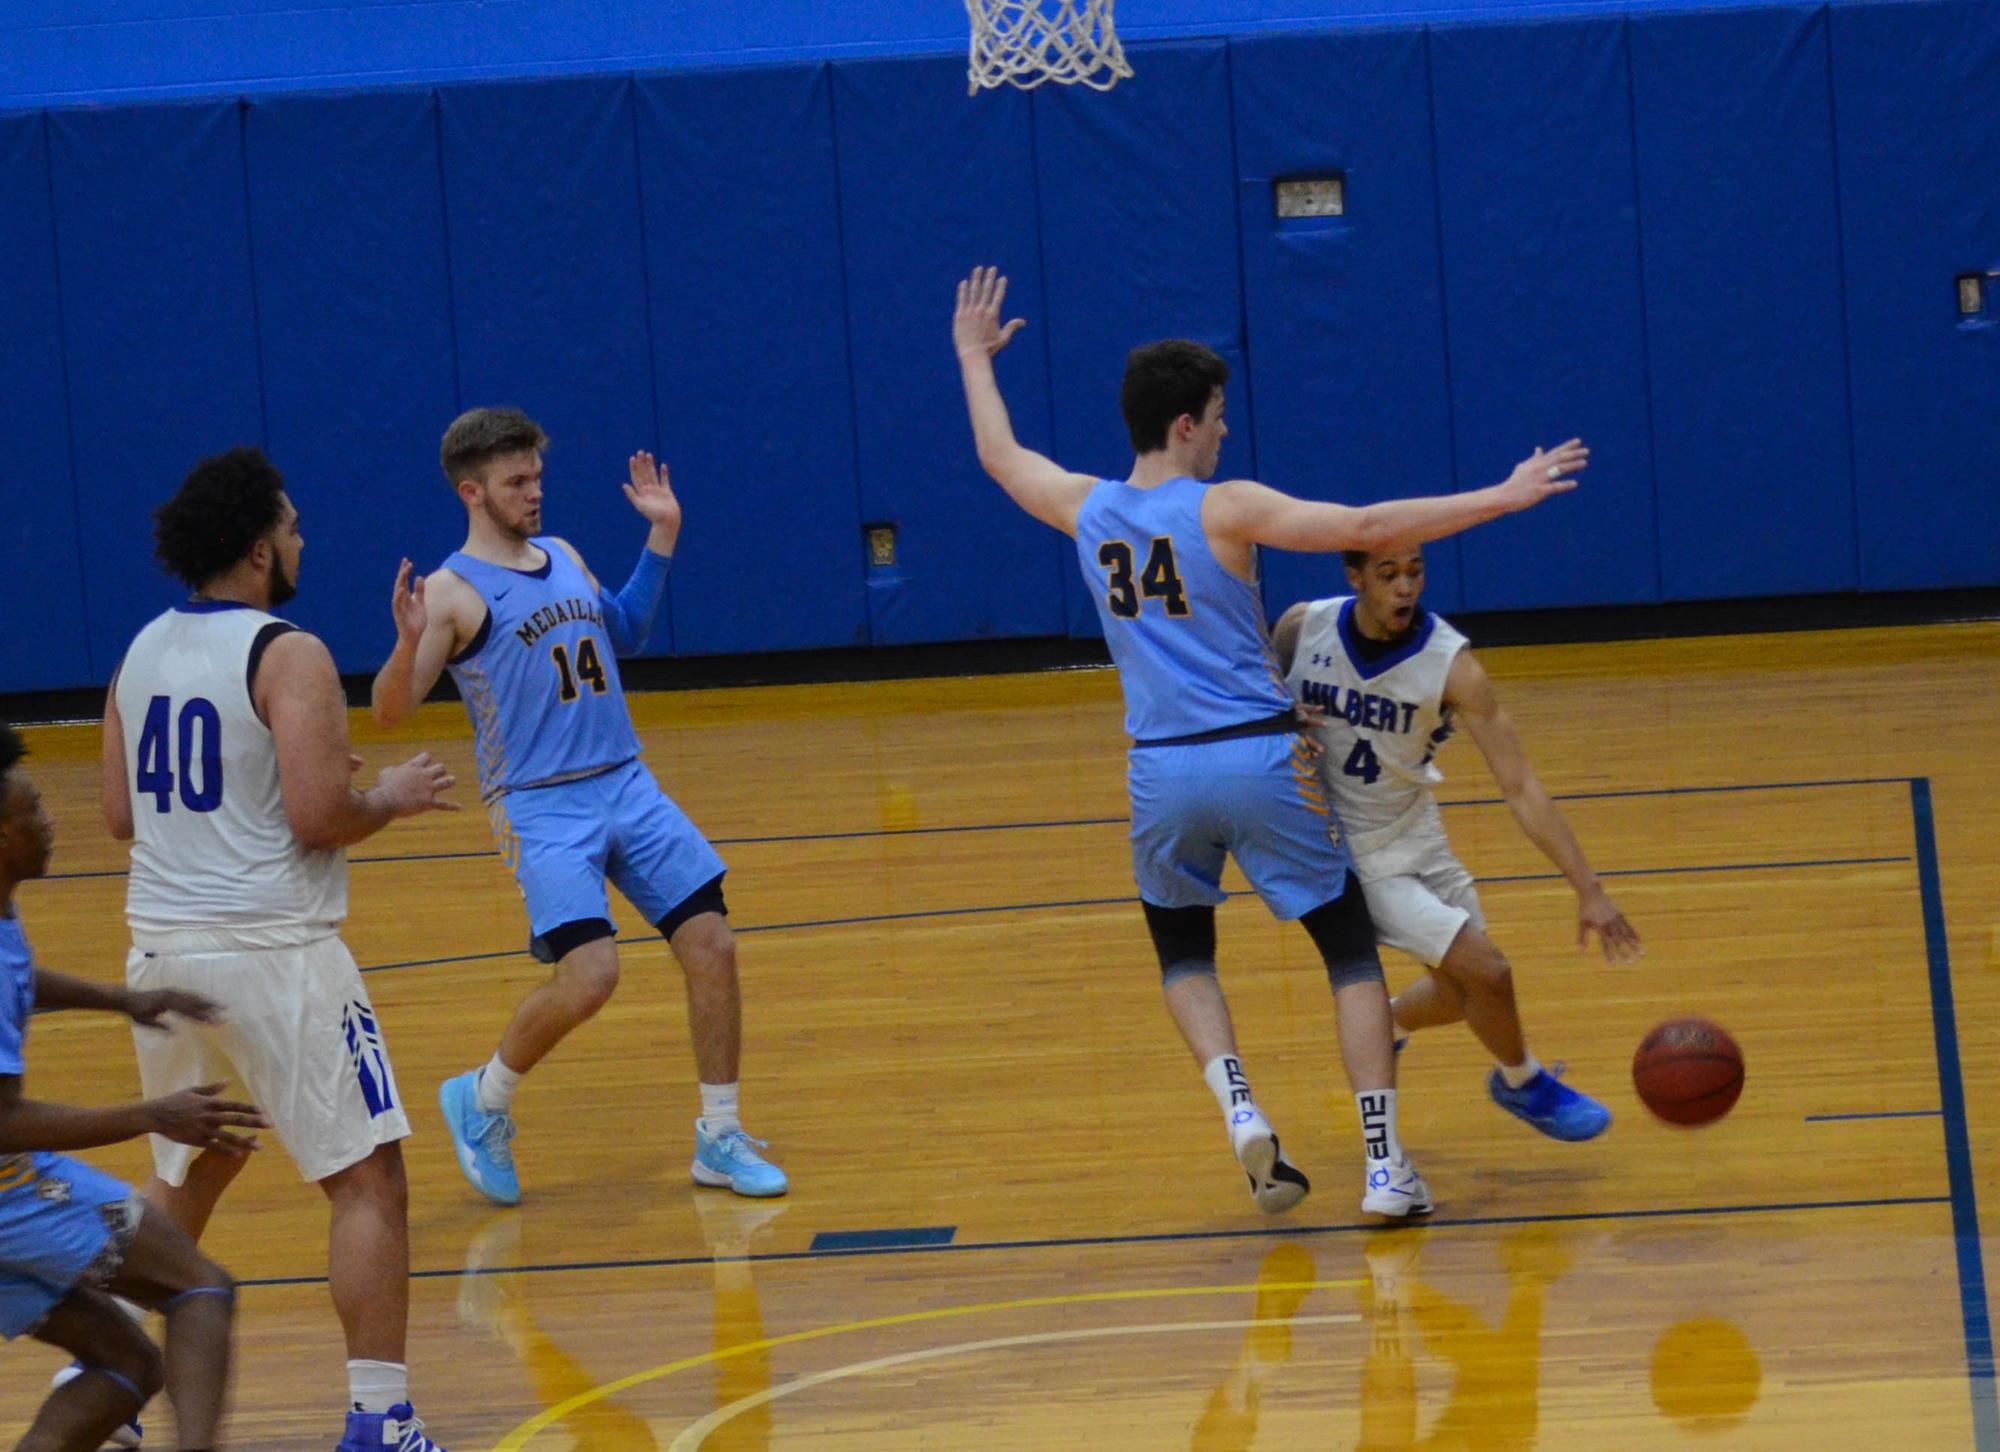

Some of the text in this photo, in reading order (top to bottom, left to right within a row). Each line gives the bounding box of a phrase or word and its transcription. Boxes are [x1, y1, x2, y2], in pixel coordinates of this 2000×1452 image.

[1097, 535, 1192, 618] 34
[551, 643, 607, 703] 14
[137, 695, 223, 813] 40
[1343, 738, 1381, 785] 4
